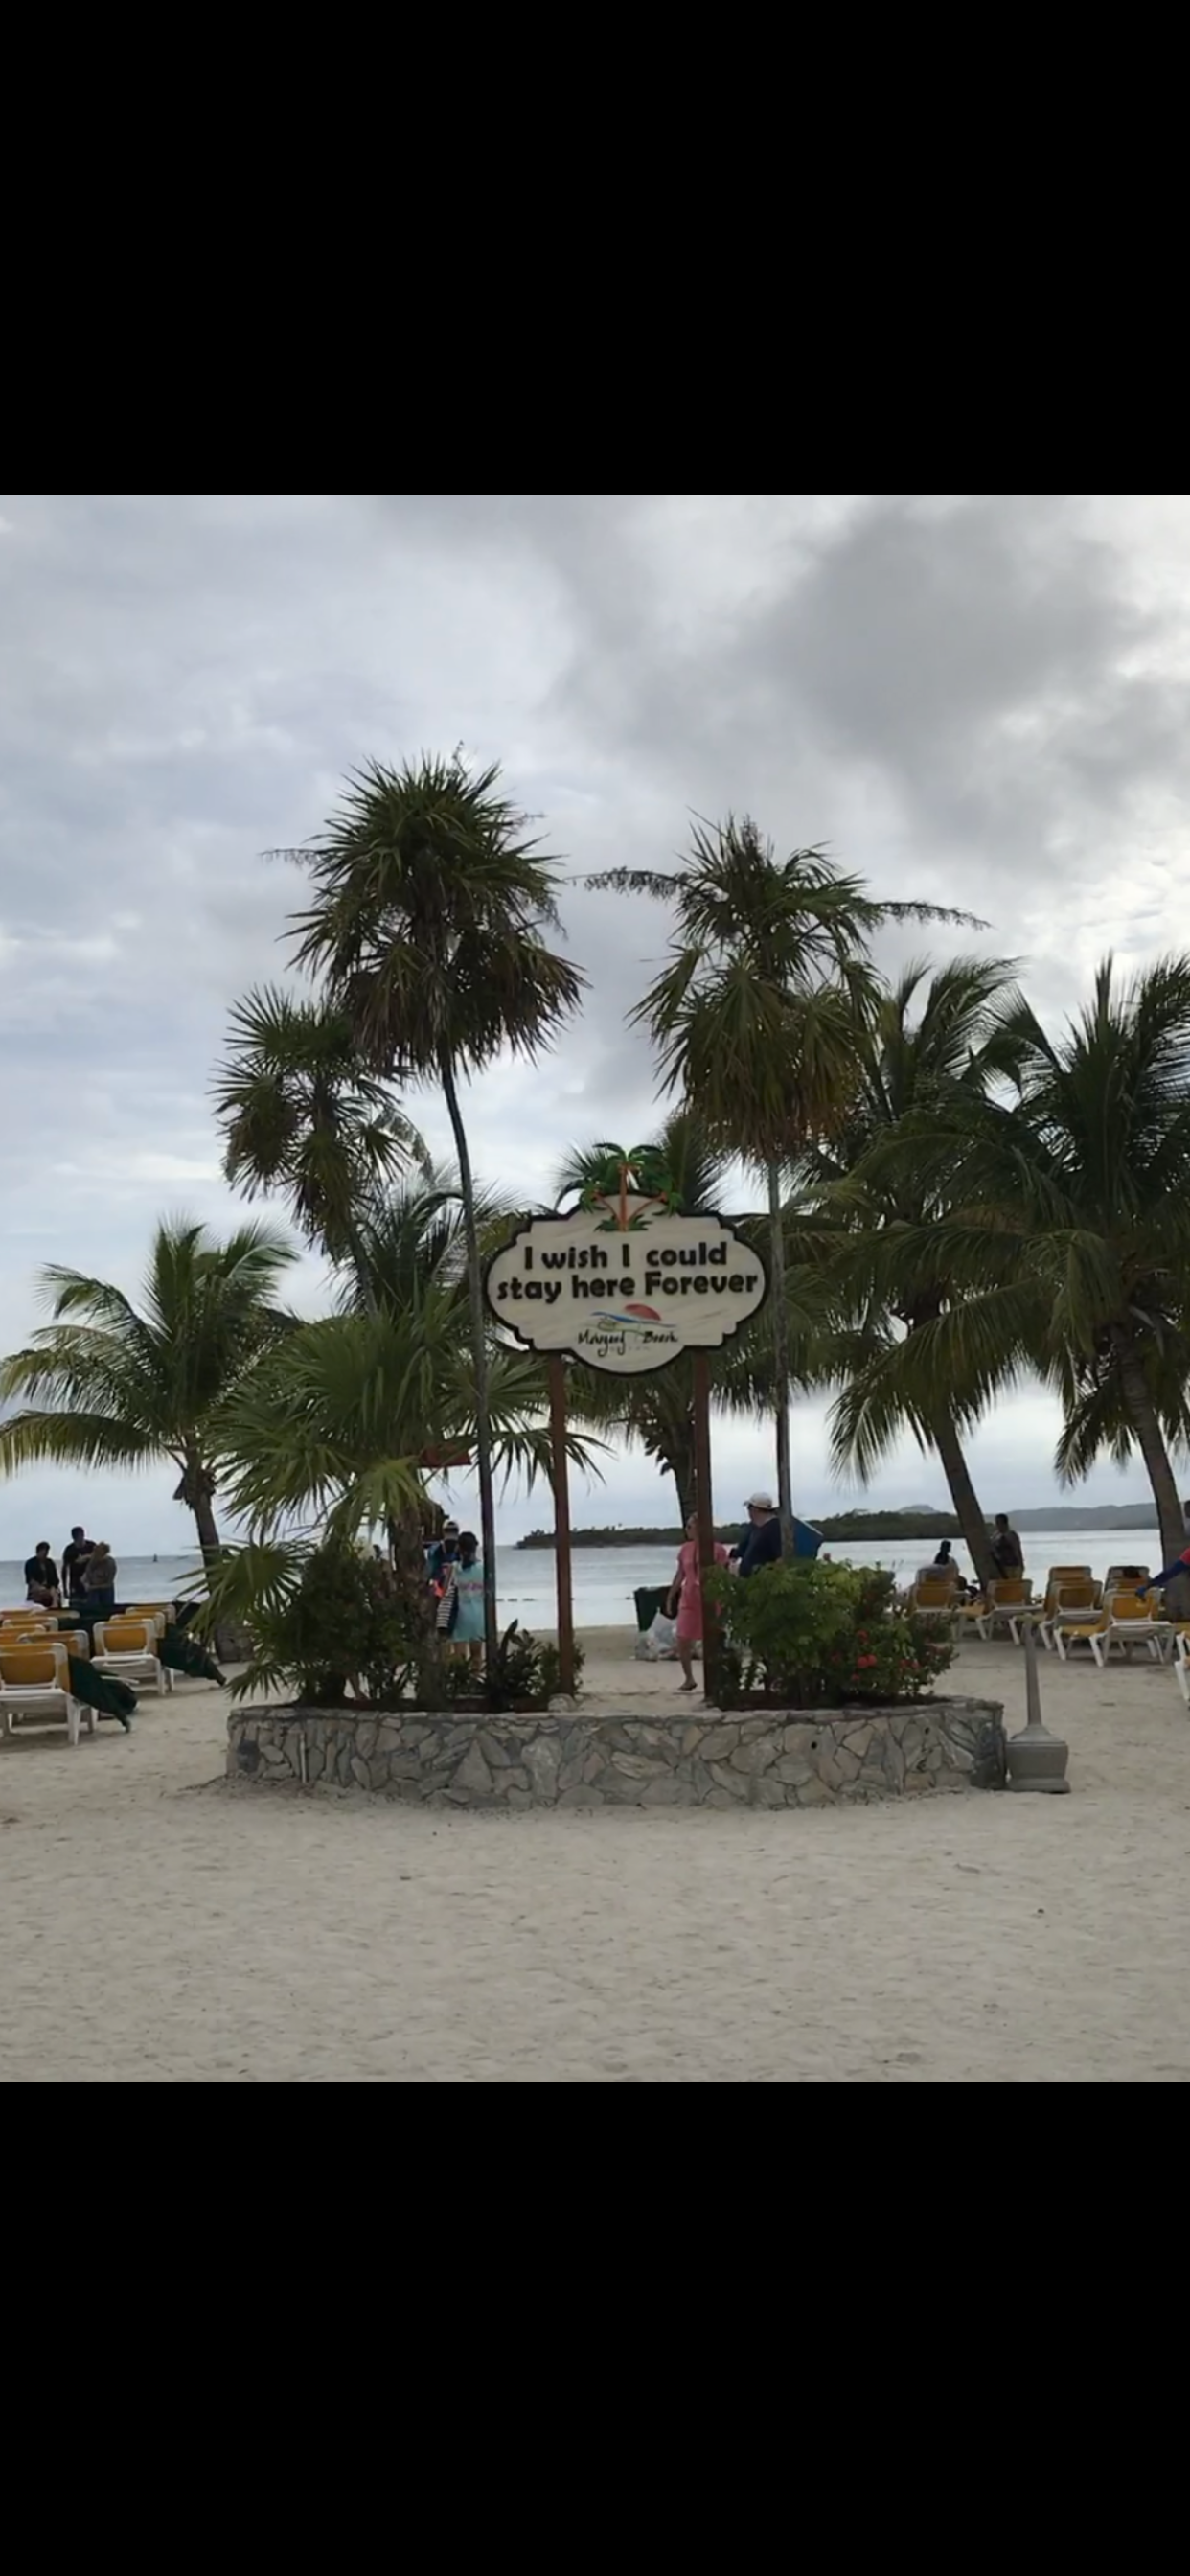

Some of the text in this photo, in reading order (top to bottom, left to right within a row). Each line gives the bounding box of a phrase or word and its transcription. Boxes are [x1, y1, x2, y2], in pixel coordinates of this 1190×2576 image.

[524, 1241, 727, 1270] I wish I could
[497, 1271, 758, 1304] stay here Forever
